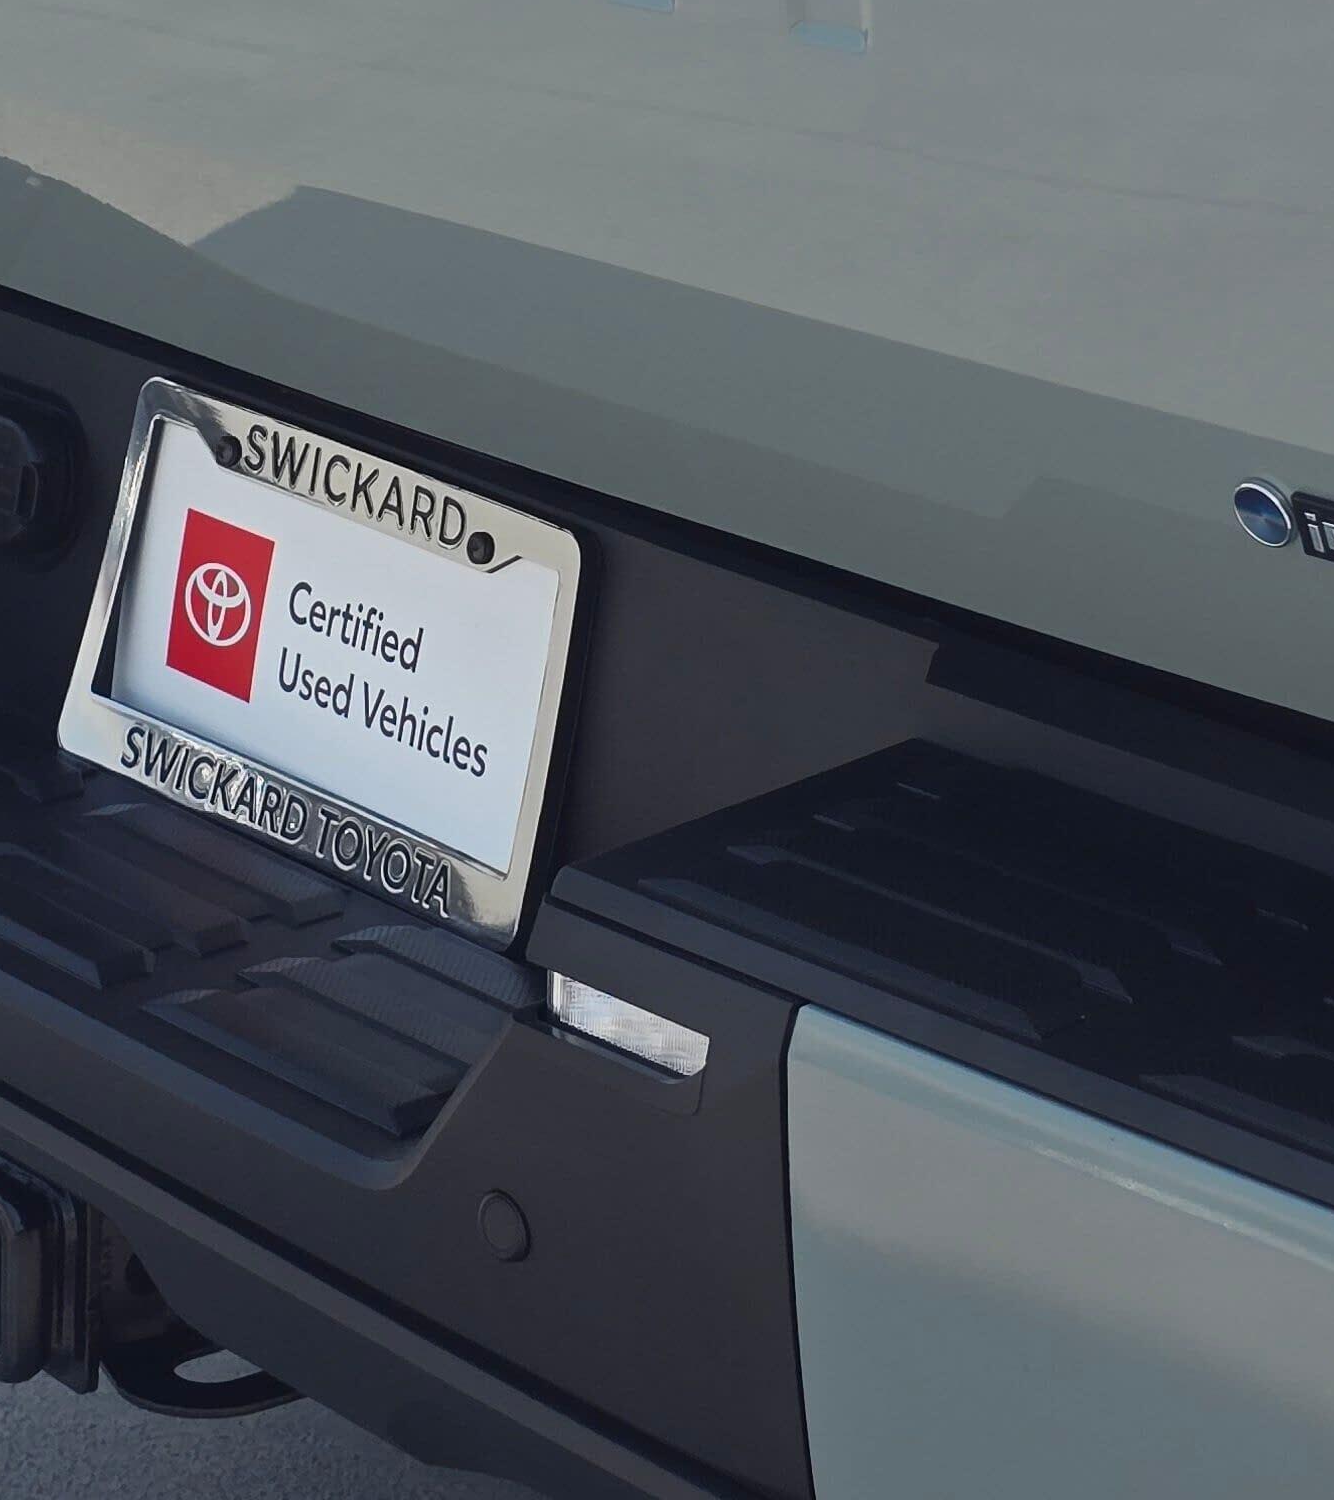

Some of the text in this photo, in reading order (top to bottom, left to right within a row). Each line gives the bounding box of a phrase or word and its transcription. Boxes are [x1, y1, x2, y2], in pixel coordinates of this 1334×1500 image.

[244, 424, 467, 551] SWICKARD
[288, 581, 424, 673] Certified
[278, 647, 489, 777] Used Vehicles
[119, 726, 451, 919] SWICKARD TOYOTA
